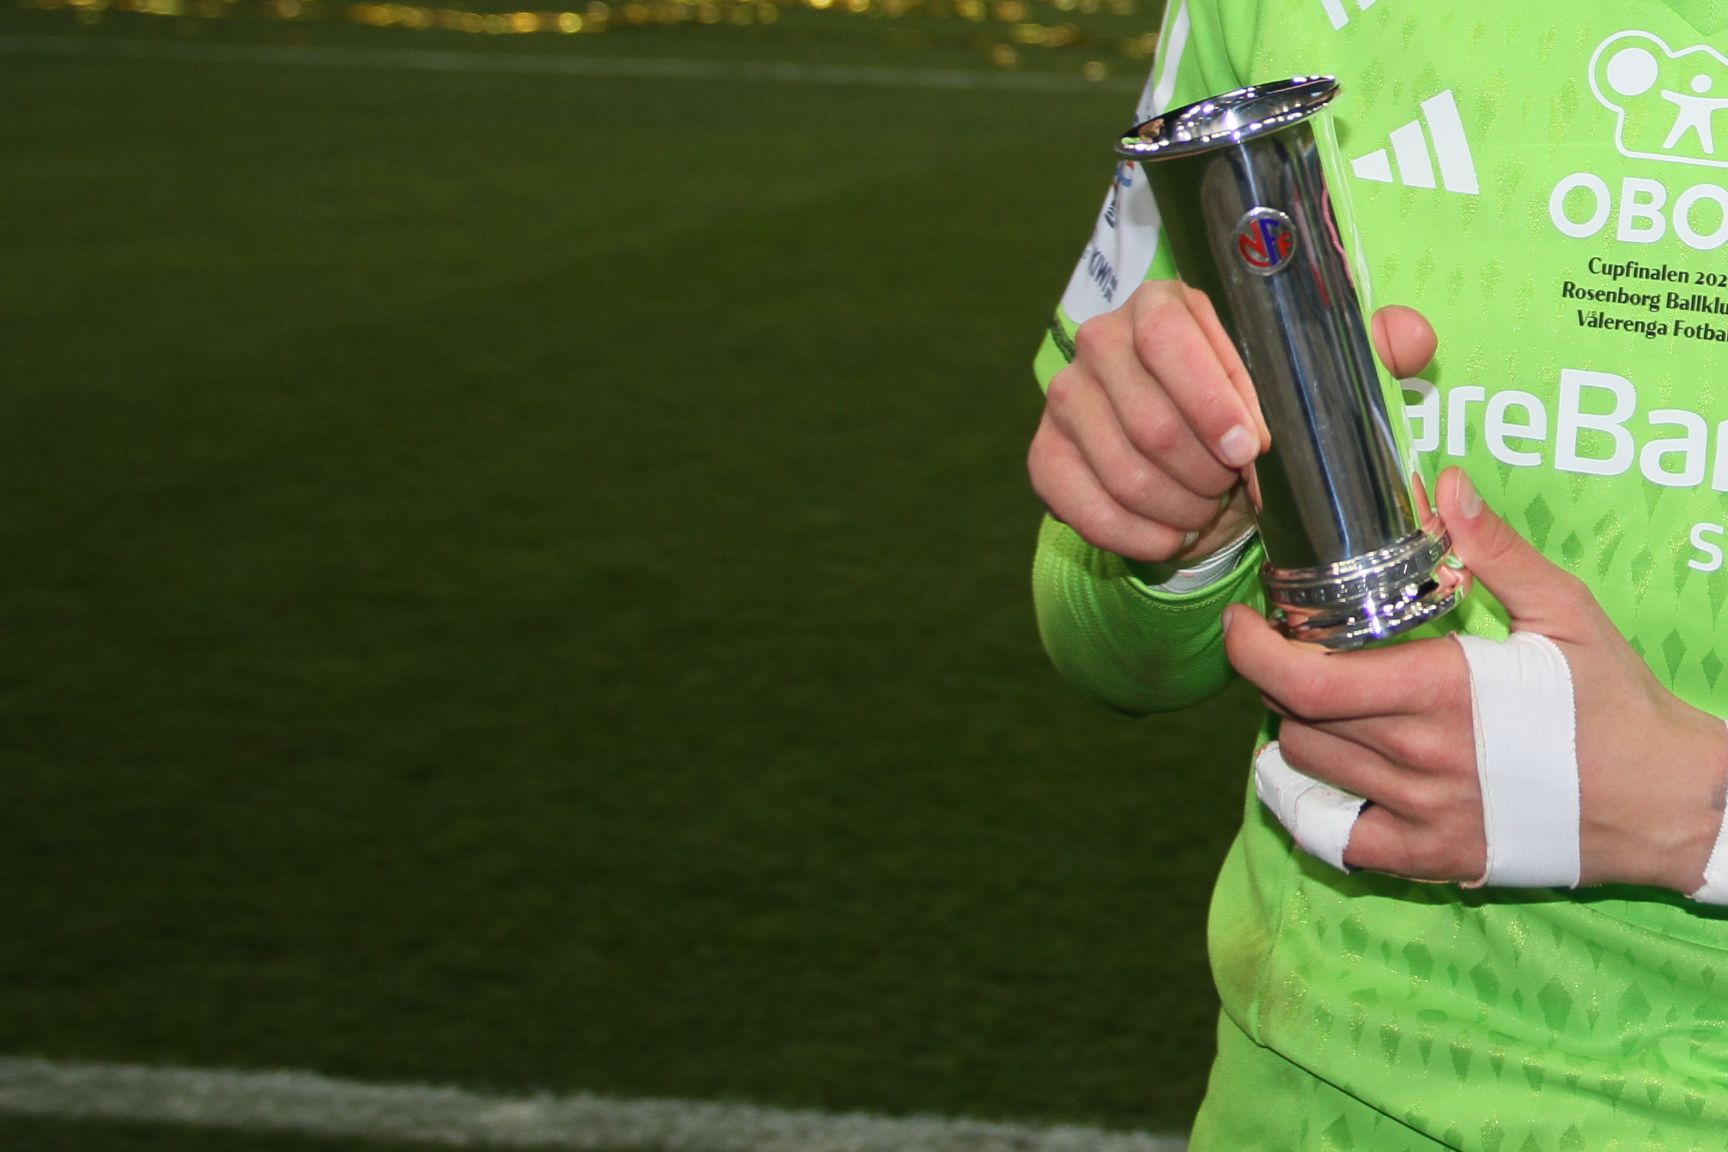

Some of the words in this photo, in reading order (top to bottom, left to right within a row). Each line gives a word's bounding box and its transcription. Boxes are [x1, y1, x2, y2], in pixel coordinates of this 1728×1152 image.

[1588, 257, 1690, 283] Cupfinalen
[1562, 281, 1661, 313] Rosenborg
[1577, 309, 1668, 339] Vålerenga
